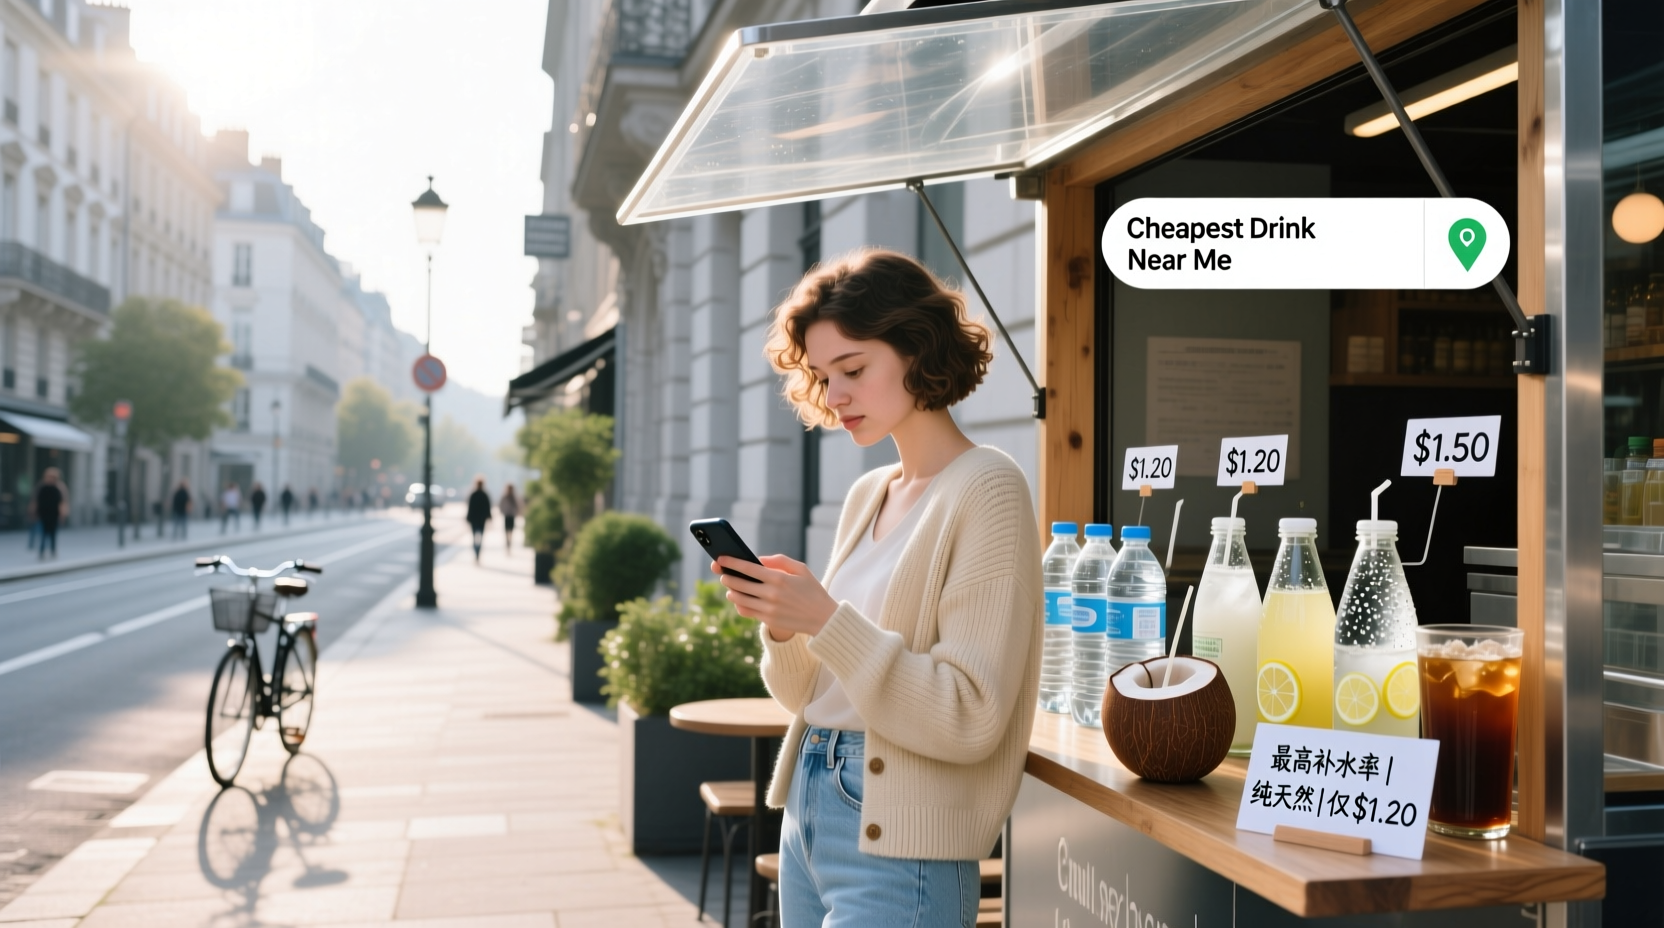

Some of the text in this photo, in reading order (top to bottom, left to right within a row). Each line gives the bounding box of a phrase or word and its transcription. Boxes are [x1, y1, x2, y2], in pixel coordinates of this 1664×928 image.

[1225, 447, 1281, 478] $1.20
[1413, 428, 1490, 467] $1.50
[1128, 456, 1172, 481] $1.20
